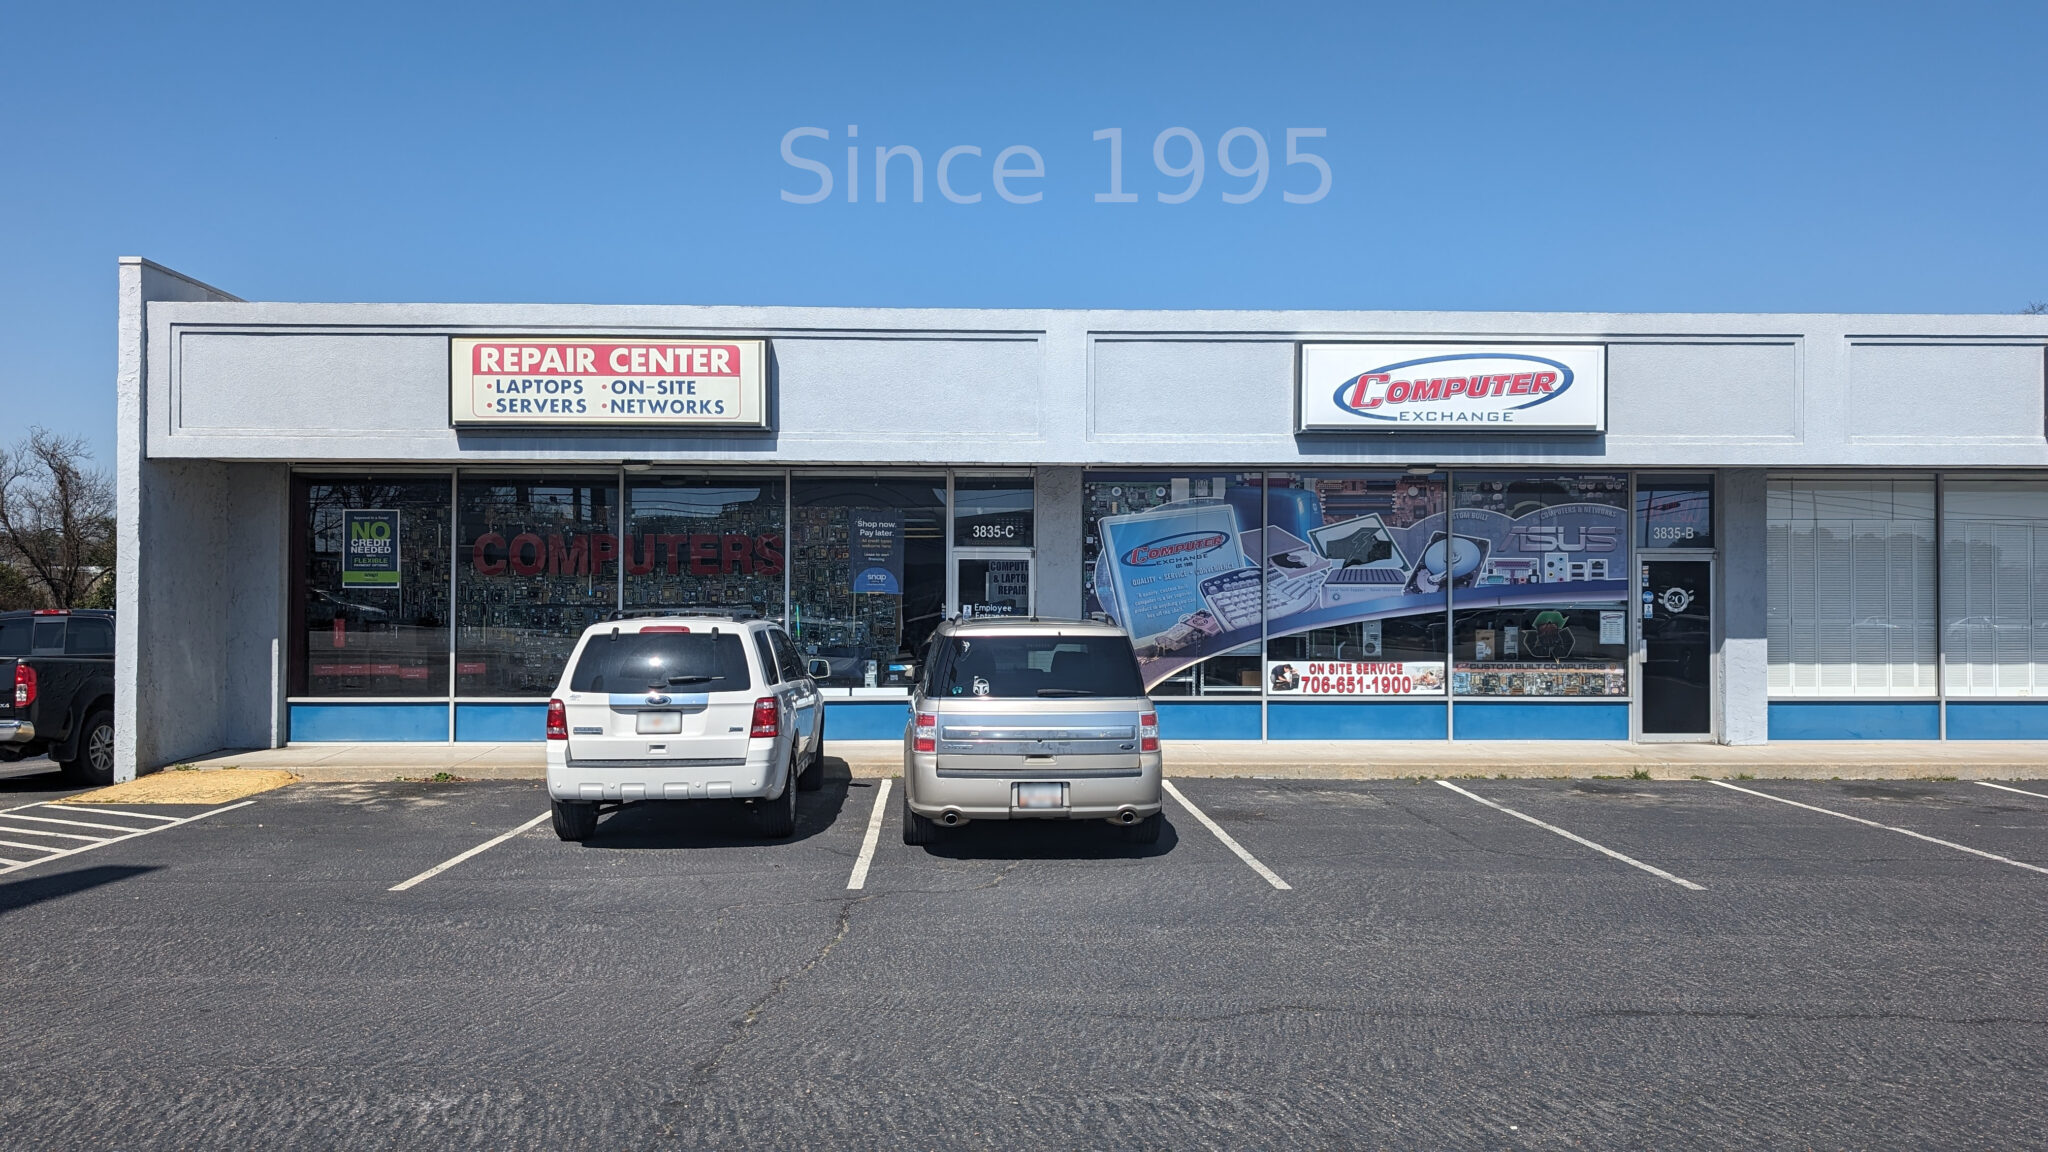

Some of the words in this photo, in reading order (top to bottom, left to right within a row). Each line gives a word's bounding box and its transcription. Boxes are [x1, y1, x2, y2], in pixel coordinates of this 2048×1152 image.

[480, 347, 598, 373] REPAIR
[609, 348, 732, 373] CENTER
[496, 379, 584, 395] LAPTOPS
[611, 380, 697, 395] ON-SITE
[1350, 370, 1557, 410] COMPUTER
[496, 398, 588, 414] SERVERS
[610, 399, 725, 415] NETWORKS
[1399, 411, 1514, 423] EXCHANGE
[1540, 505, 1576, 520] COMPUTERS
[351, 521, 391, 540] NO
[857, 520, 878, 529] Shop
[859, 529, 874, 537] Pay
[875, 529, 895, 537] later.
[972, 525, 1015, 538] 3835-C
[1653, 526, 1695, 540] 3835-B
[350, 538, 391, 547] CREDIT
[1496, 526, 1617, 552] ASUS
[350, 546, 391, 554] NEEDED
[472, 533, 785, 576] COMPUTERS
[1131, 535, 1223, 564] COMPUTER
[1156, 553, 1208, 566] EXCHANGE
[989, 561, 1028, 572] COMPUTE
[867, 573, 887, 583] snap
[993, 574, 1000, 584] &
[1132, 575, 1156, 586] QUALITY
[998, 585, 1027, 595] REPAIR
[1668, 594, 1685, 606] 20
[974, 603, 1012, 613] Employee
[1309, 663, 1325, 675] ON
[1328, 663, 1352, 675] SITE
[1355, 663, 1404, 675] SERVICE
[1301, 675, 1412, 693] 706-651-1900
